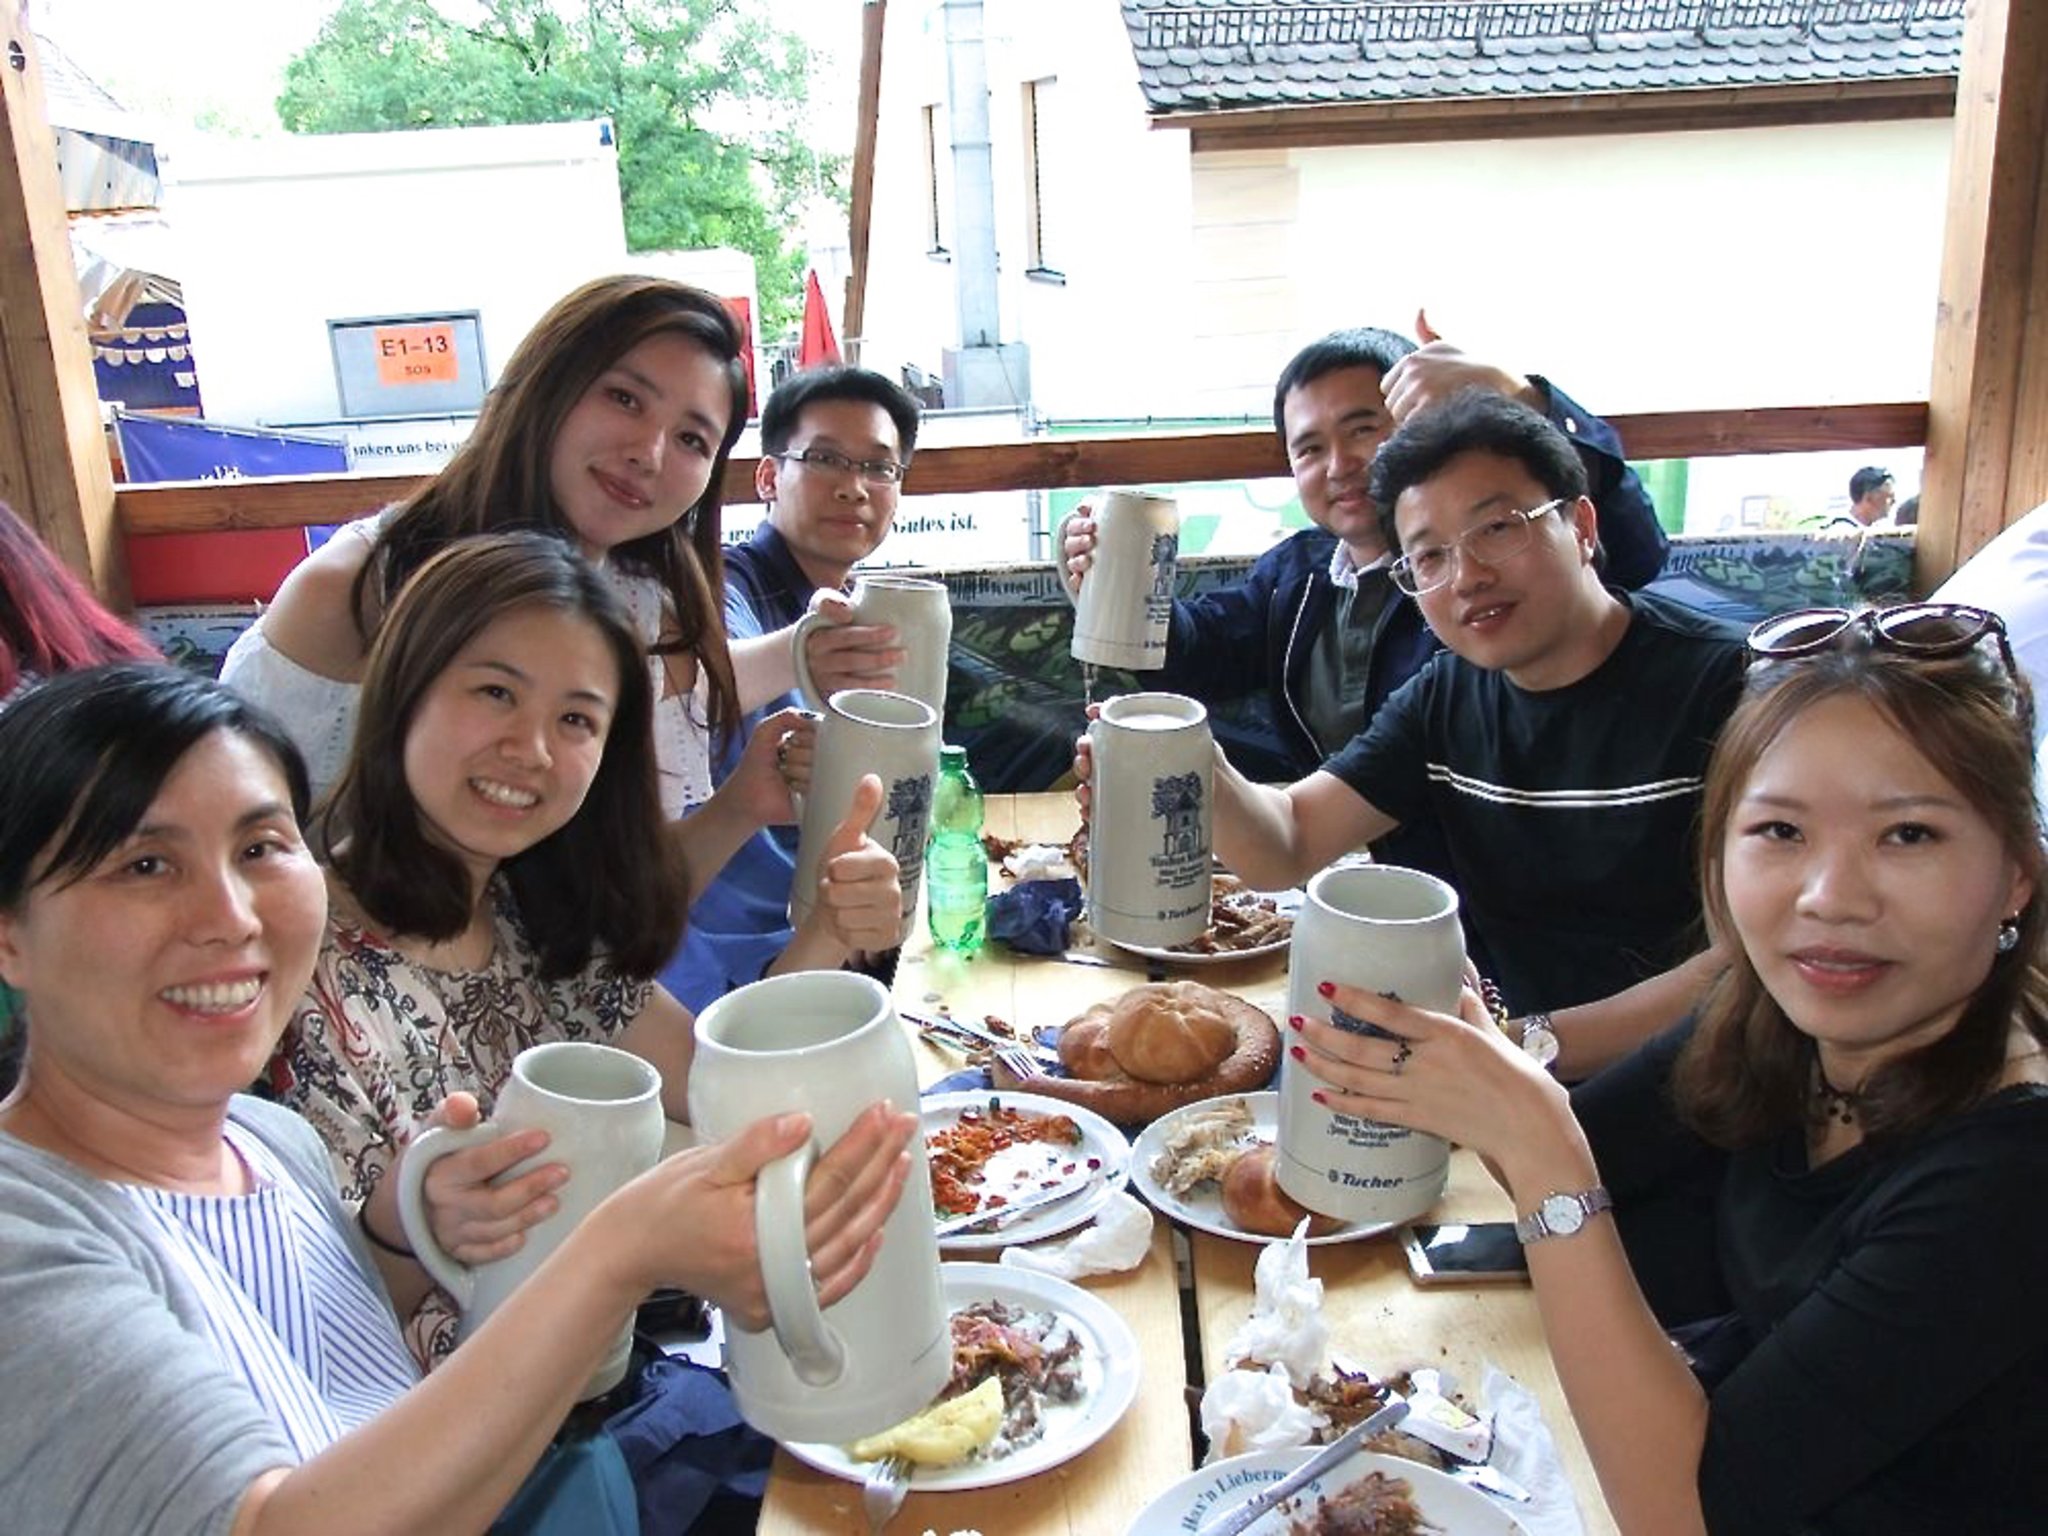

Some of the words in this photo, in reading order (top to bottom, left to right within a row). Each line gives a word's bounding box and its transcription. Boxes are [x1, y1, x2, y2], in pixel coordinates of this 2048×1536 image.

[381, 335, 448, 356] E1-13
[396, 443, 422, 454] uns
[951, 512, 977, 531] ist.
[1168, 902, 1204, 919] Tucher
[1343, 1173, 1403, 1188] Tucher
[1216, 1469, 1321, 1494] Liebermn
